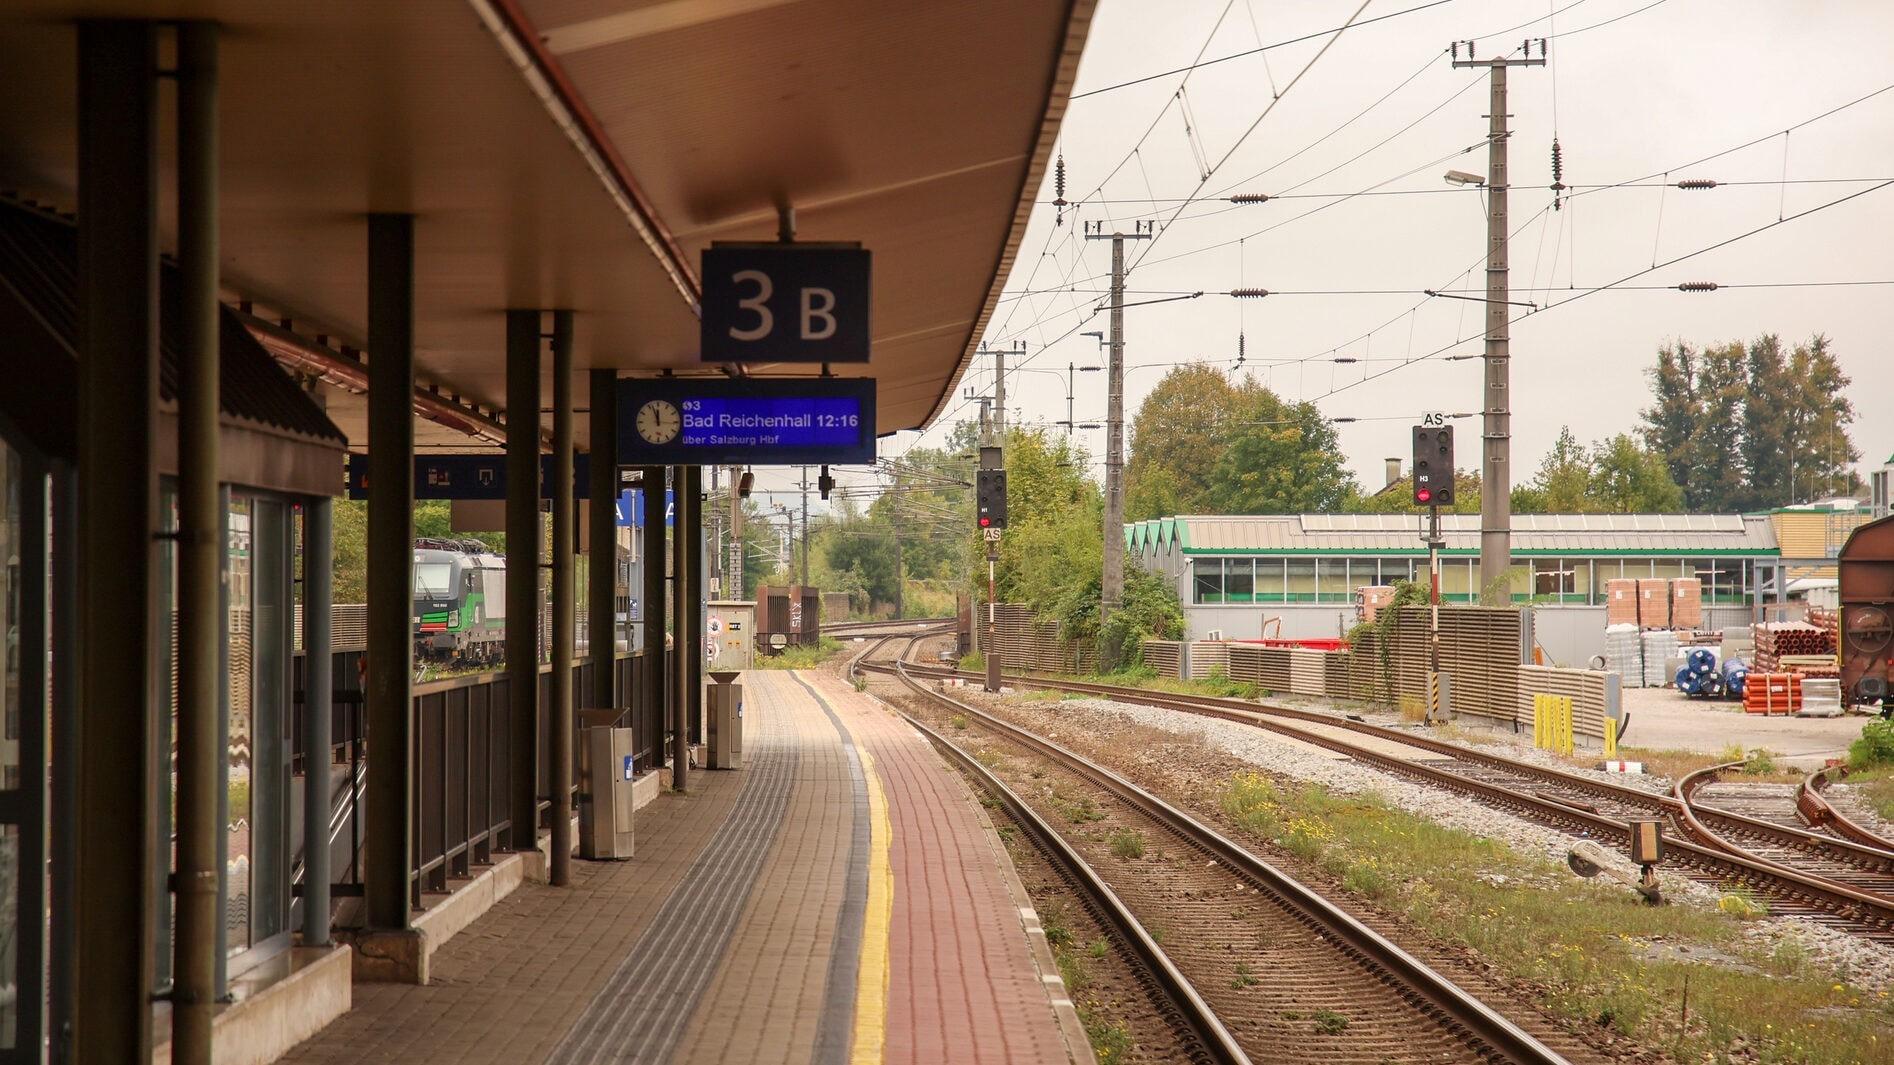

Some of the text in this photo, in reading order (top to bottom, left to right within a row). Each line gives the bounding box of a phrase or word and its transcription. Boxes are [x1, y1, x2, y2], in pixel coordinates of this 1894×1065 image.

[729, 270, 837, 341] 3 B
[683, 414, 858, 428] Bad Reichenhall 12:16
[1424, 413, 1443, 425] AS
[682, 435, 779, 446] über Salzburg Hbf
[984, 529, 1000, 539] AS
